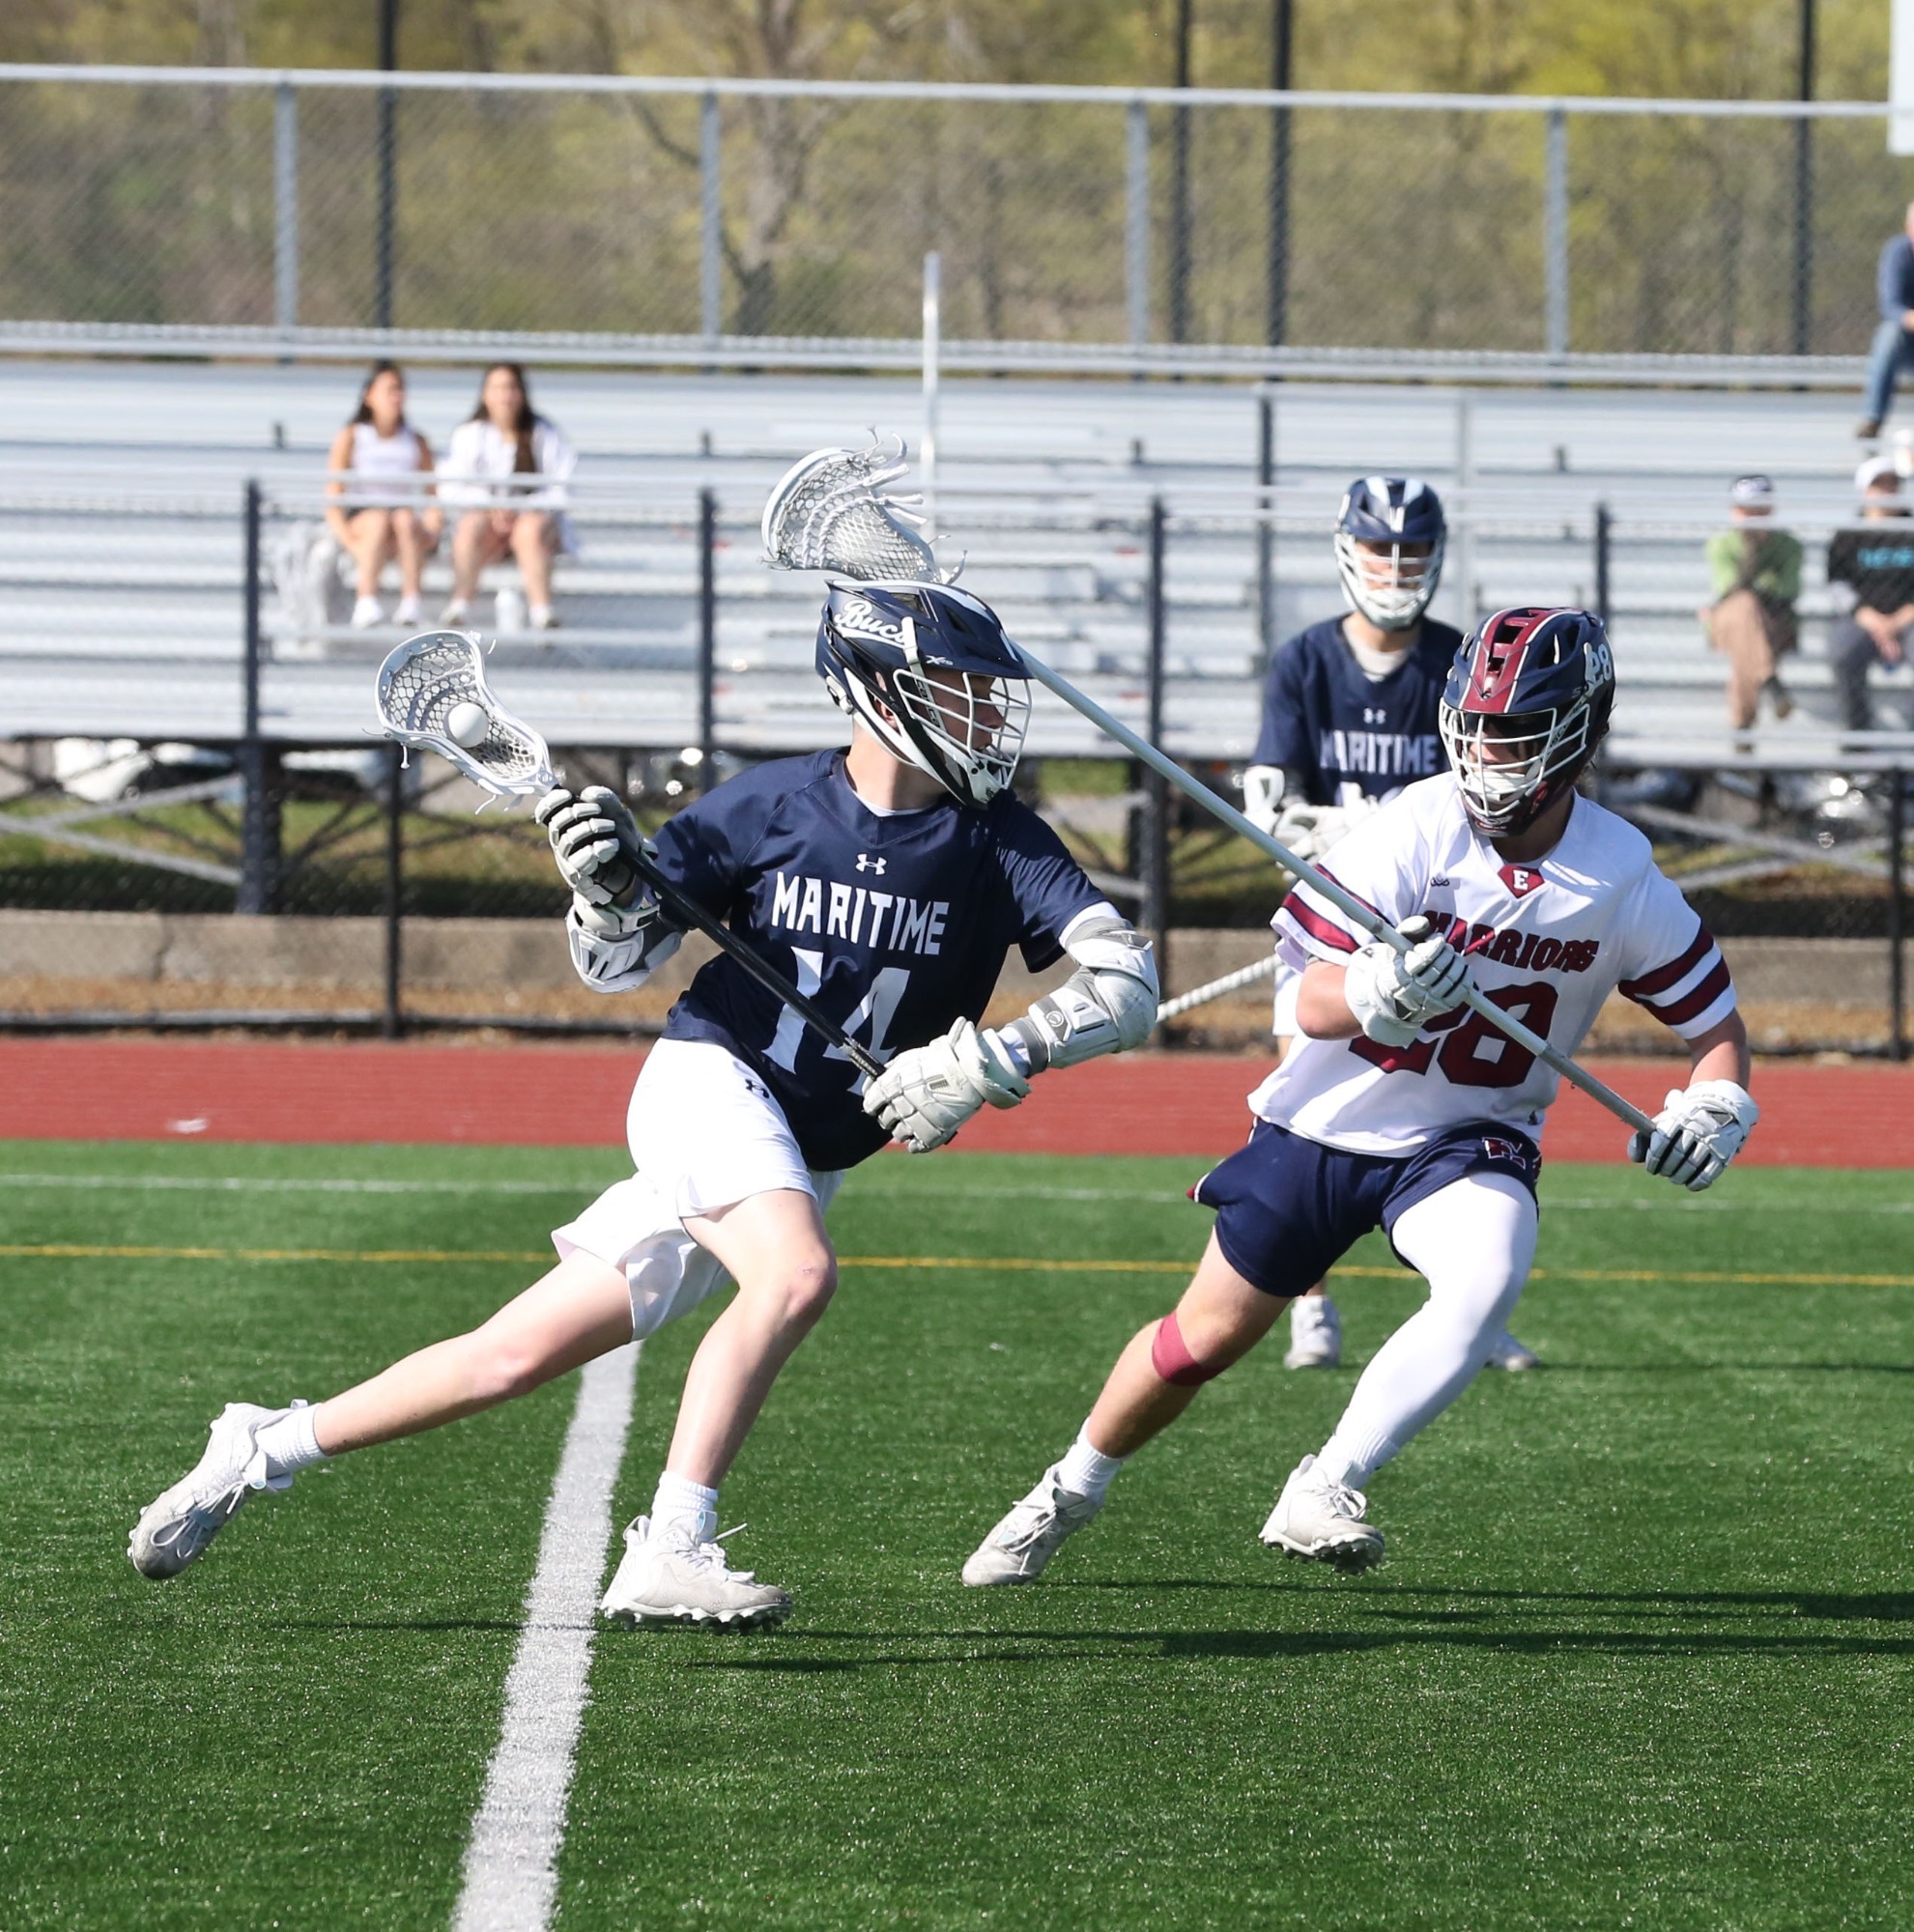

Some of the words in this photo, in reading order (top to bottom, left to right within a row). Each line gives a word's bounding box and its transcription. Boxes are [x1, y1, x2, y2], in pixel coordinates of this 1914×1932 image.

[1320, 729, 1439, 775] MARITIME
[1513, 869, 1529, 891] E
[771, 871, 950, 955] MARITIME
[760, 946, 911, 1095] 14
